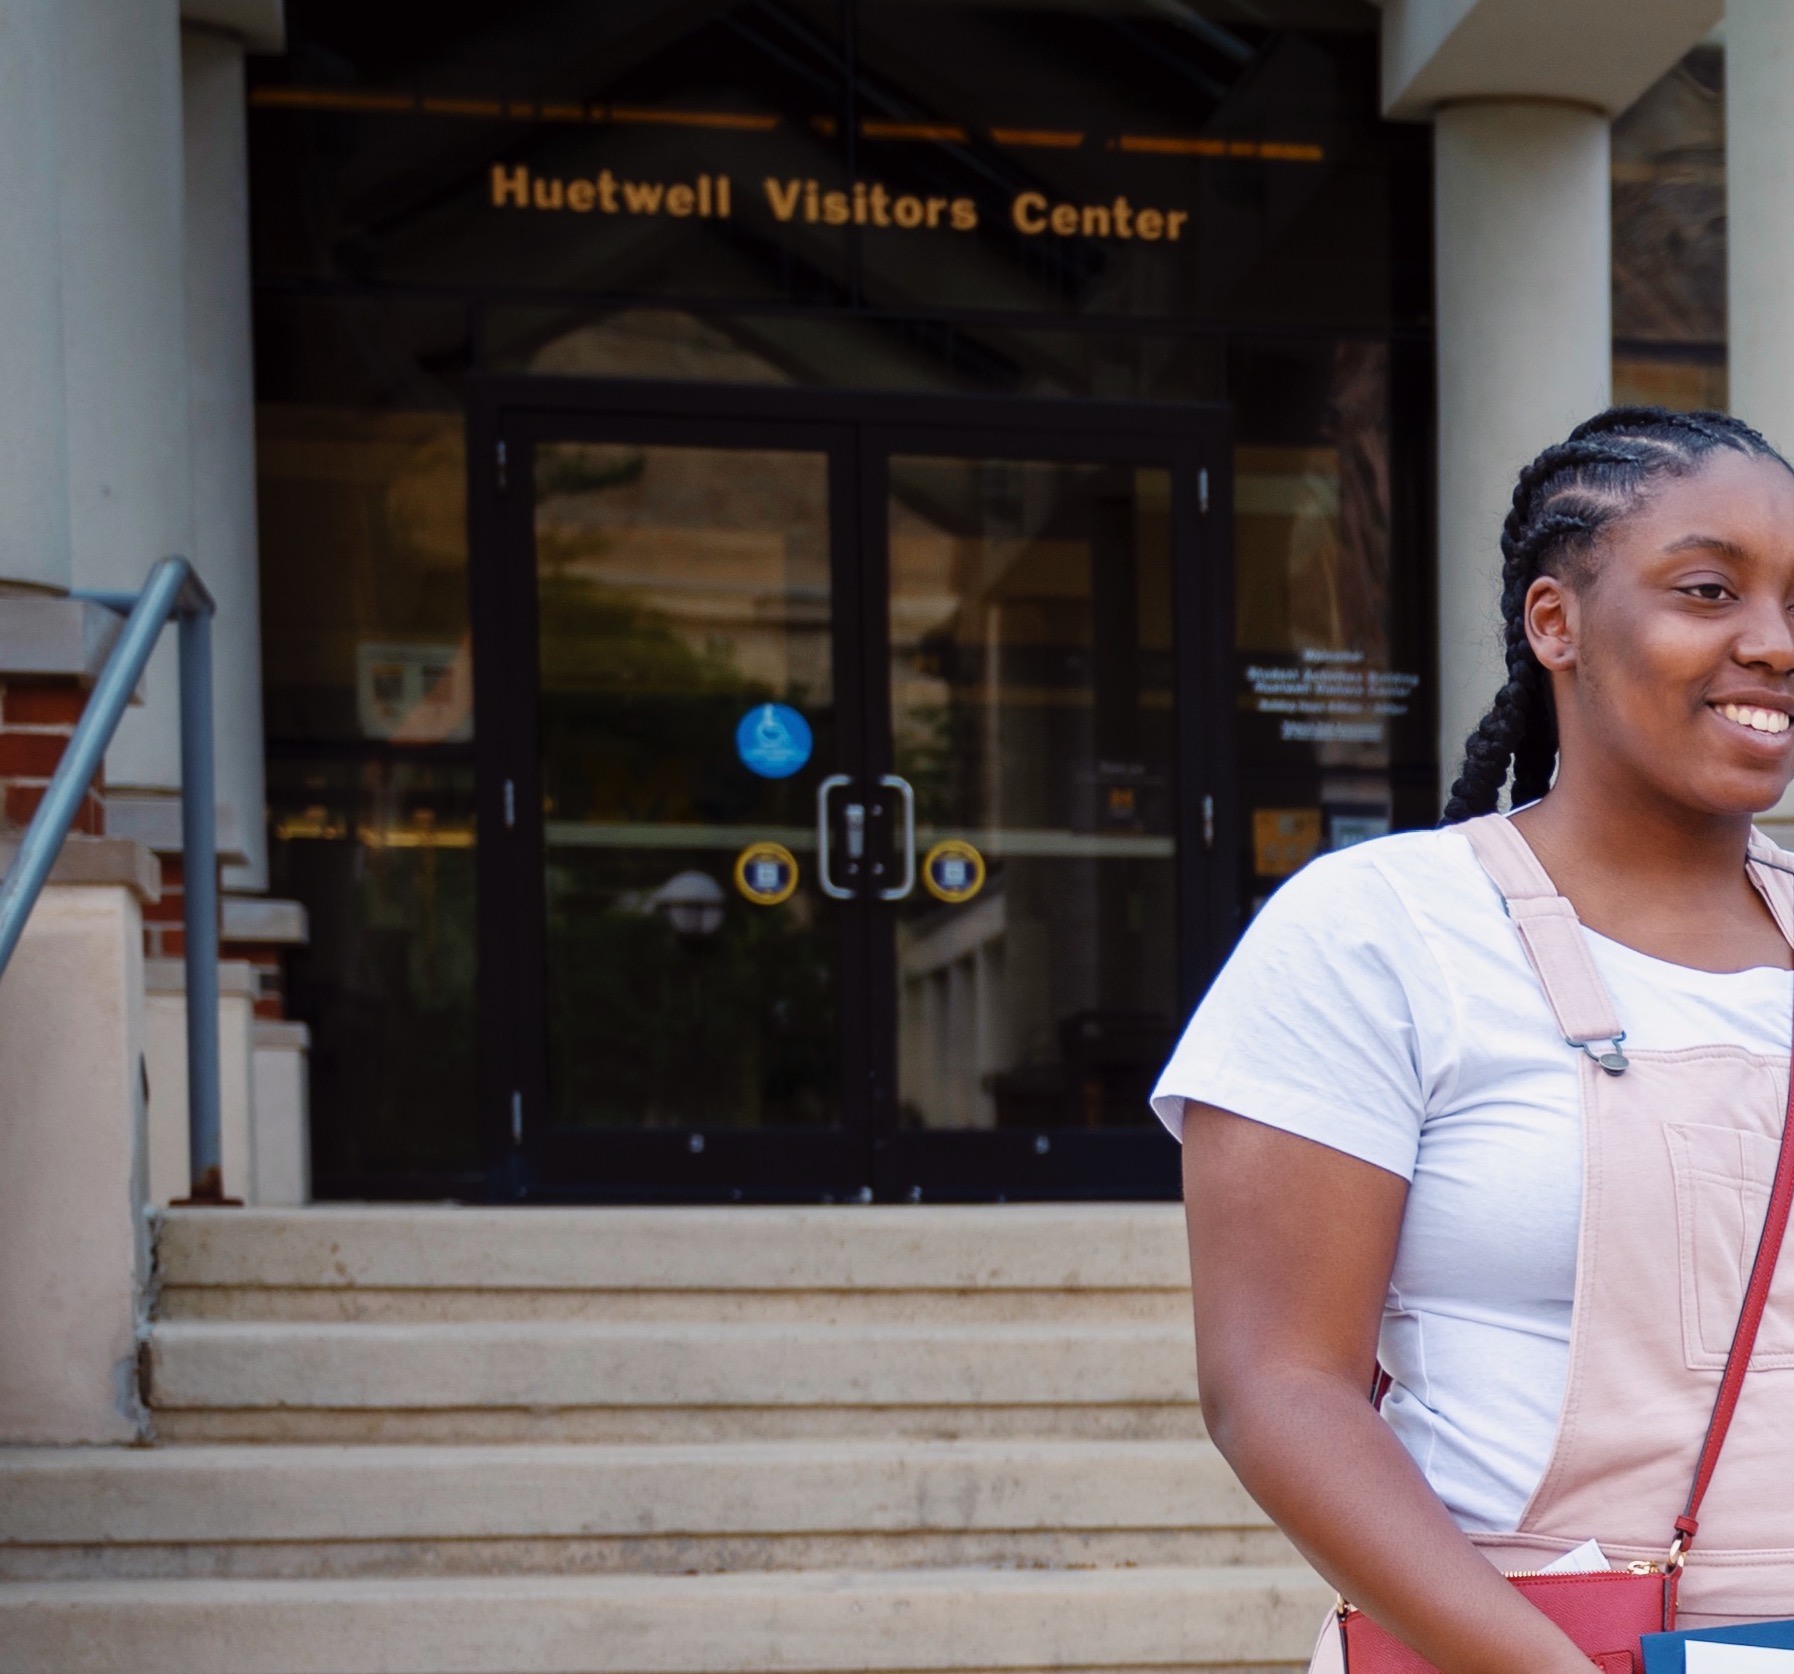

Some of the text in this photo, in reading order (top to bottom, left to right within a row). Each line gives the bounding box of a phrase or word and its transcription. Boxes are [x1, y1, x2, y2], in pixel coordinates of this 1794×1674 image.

[490, 164, 1188, 241] Huetwell Visitors Center
